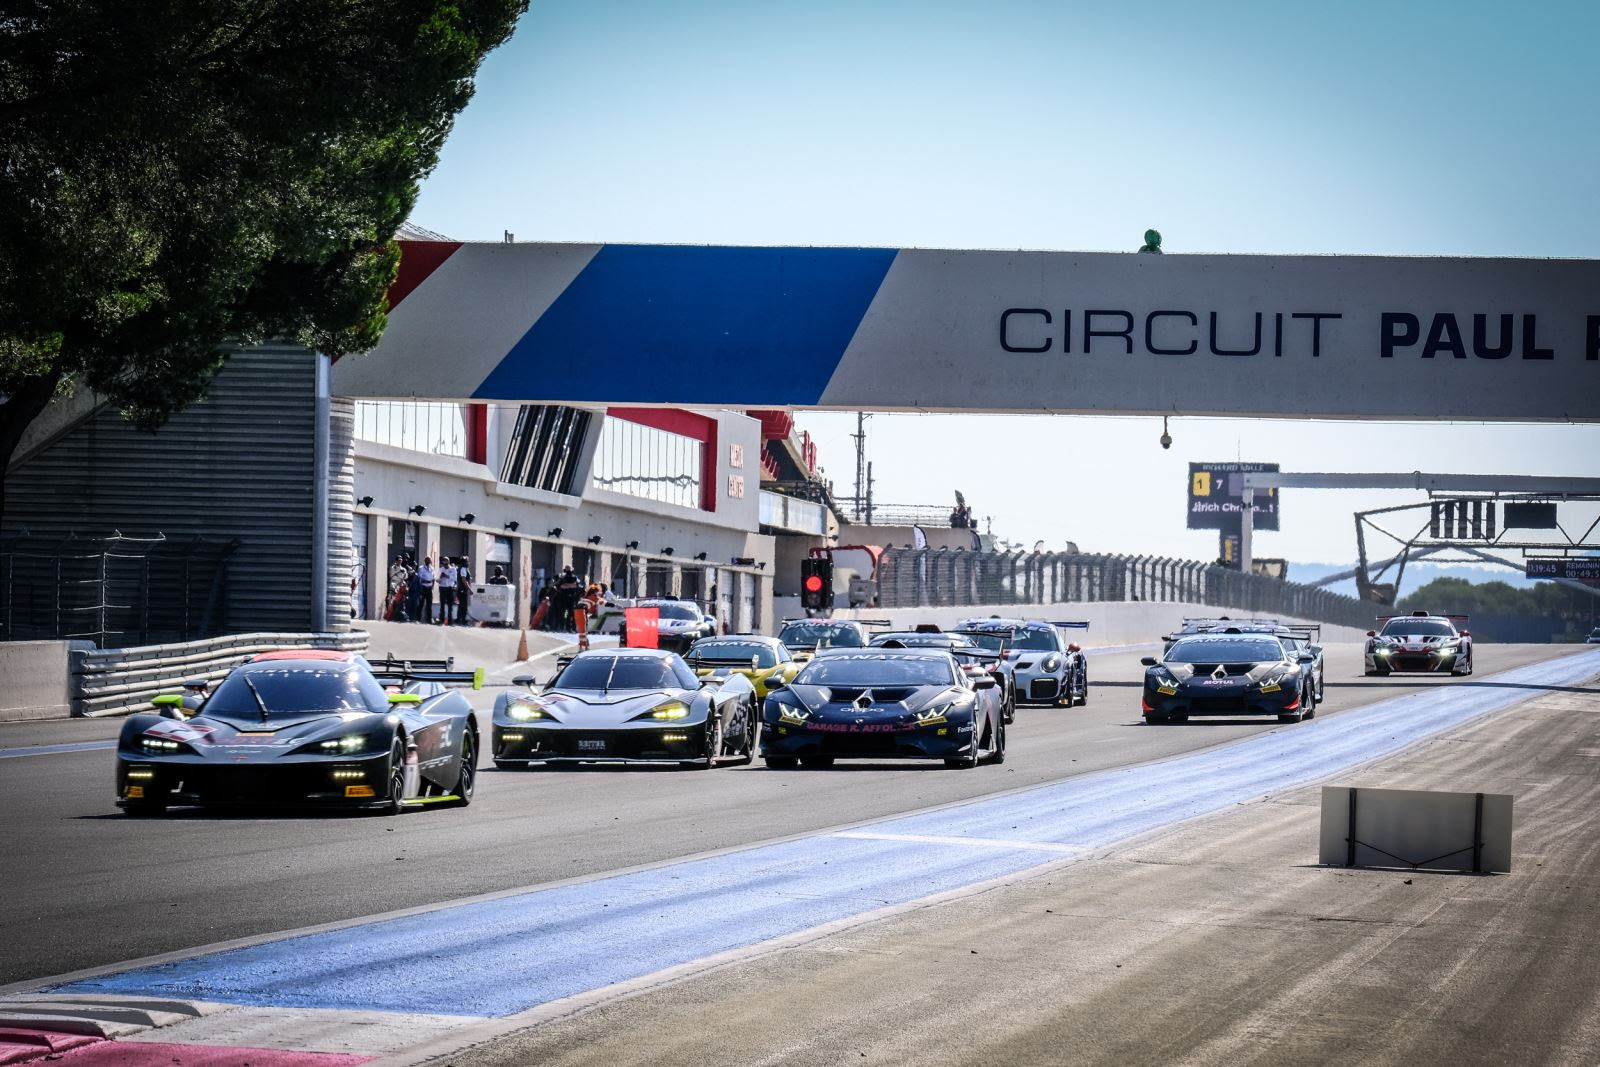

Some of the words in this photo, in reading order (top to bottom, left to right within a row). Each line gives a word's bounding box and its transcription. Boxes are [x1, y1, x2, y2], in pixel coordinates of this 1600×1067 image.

[999, 308, 1342, 357] CIRCUIT
[1380, 312, 1555, 361] PAUL
[1215, 479, 1224, 490] 7
